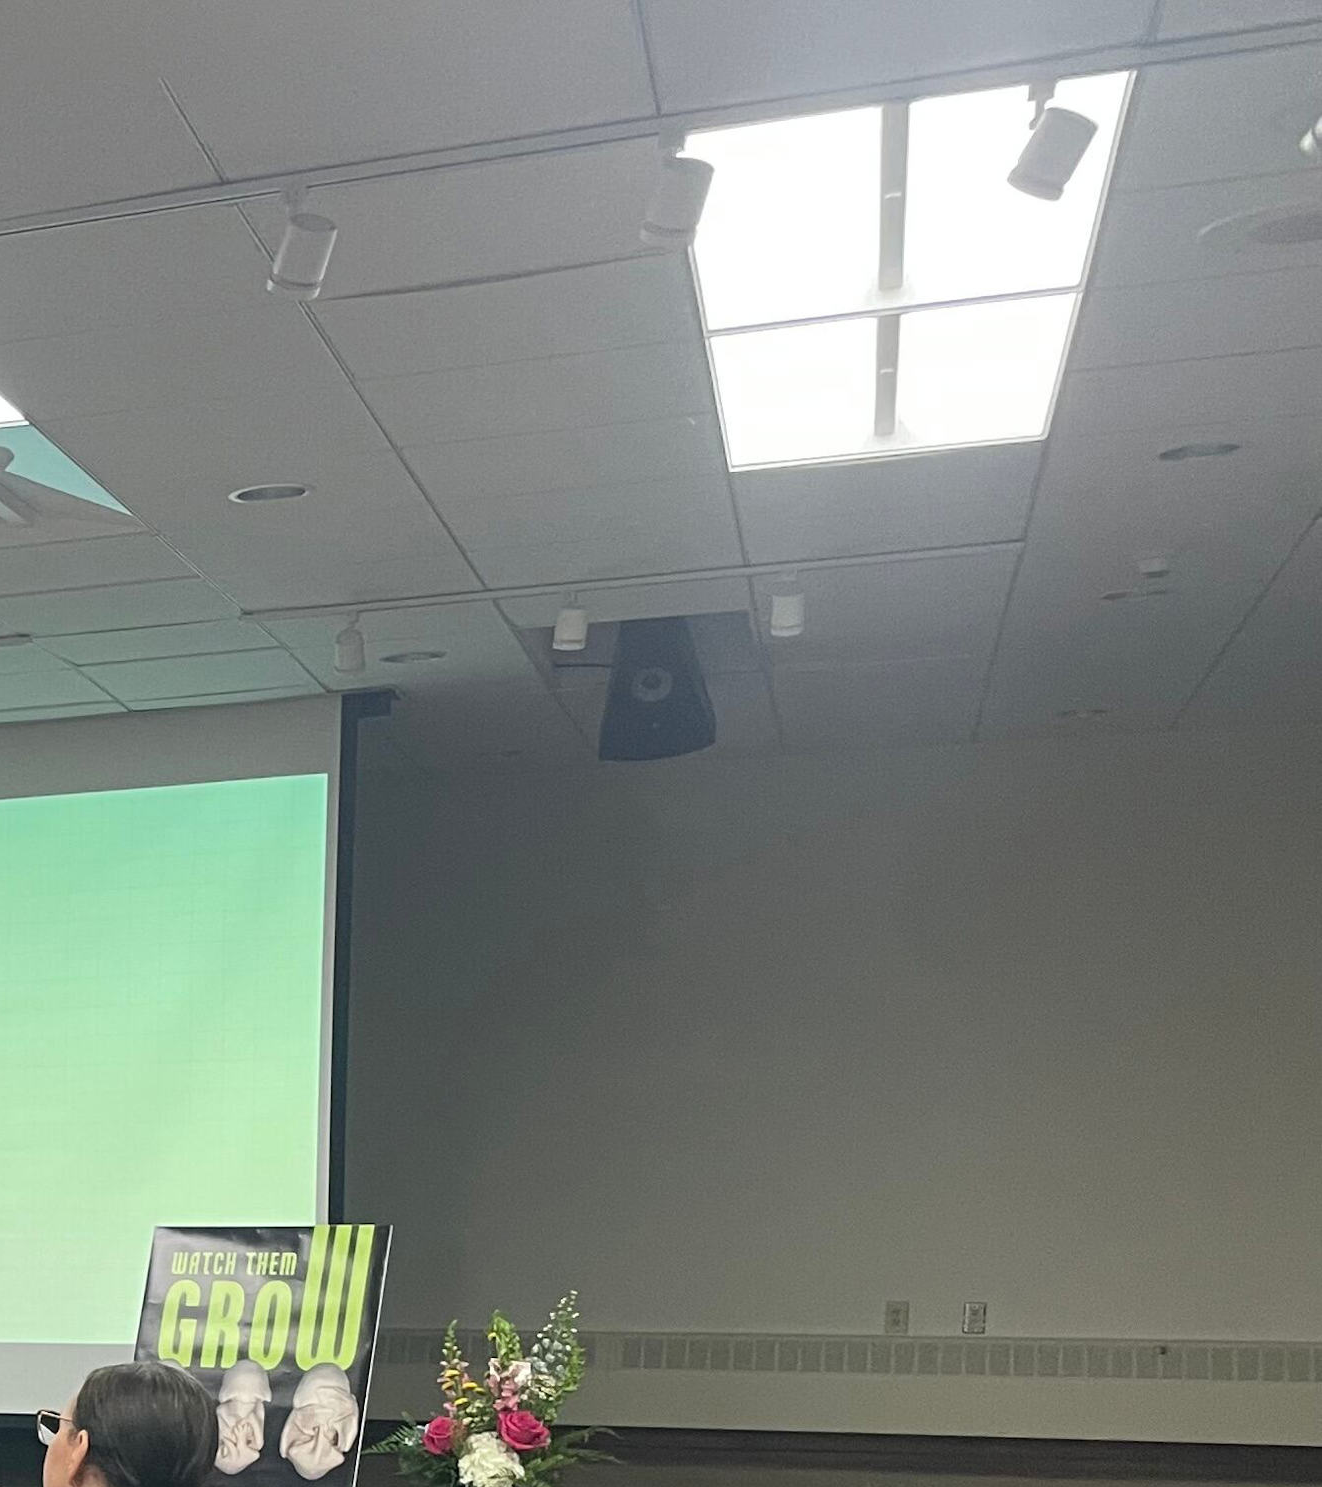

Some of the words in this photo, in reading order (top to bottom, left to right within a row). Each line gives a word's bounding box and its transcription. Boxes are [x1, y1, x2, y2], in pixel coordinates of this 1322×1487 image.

[158, 1224, 375, 1372] GROW
[171, 1251, 237, 1276] WATCH
[245, 1251, 299, 1276] THEM
